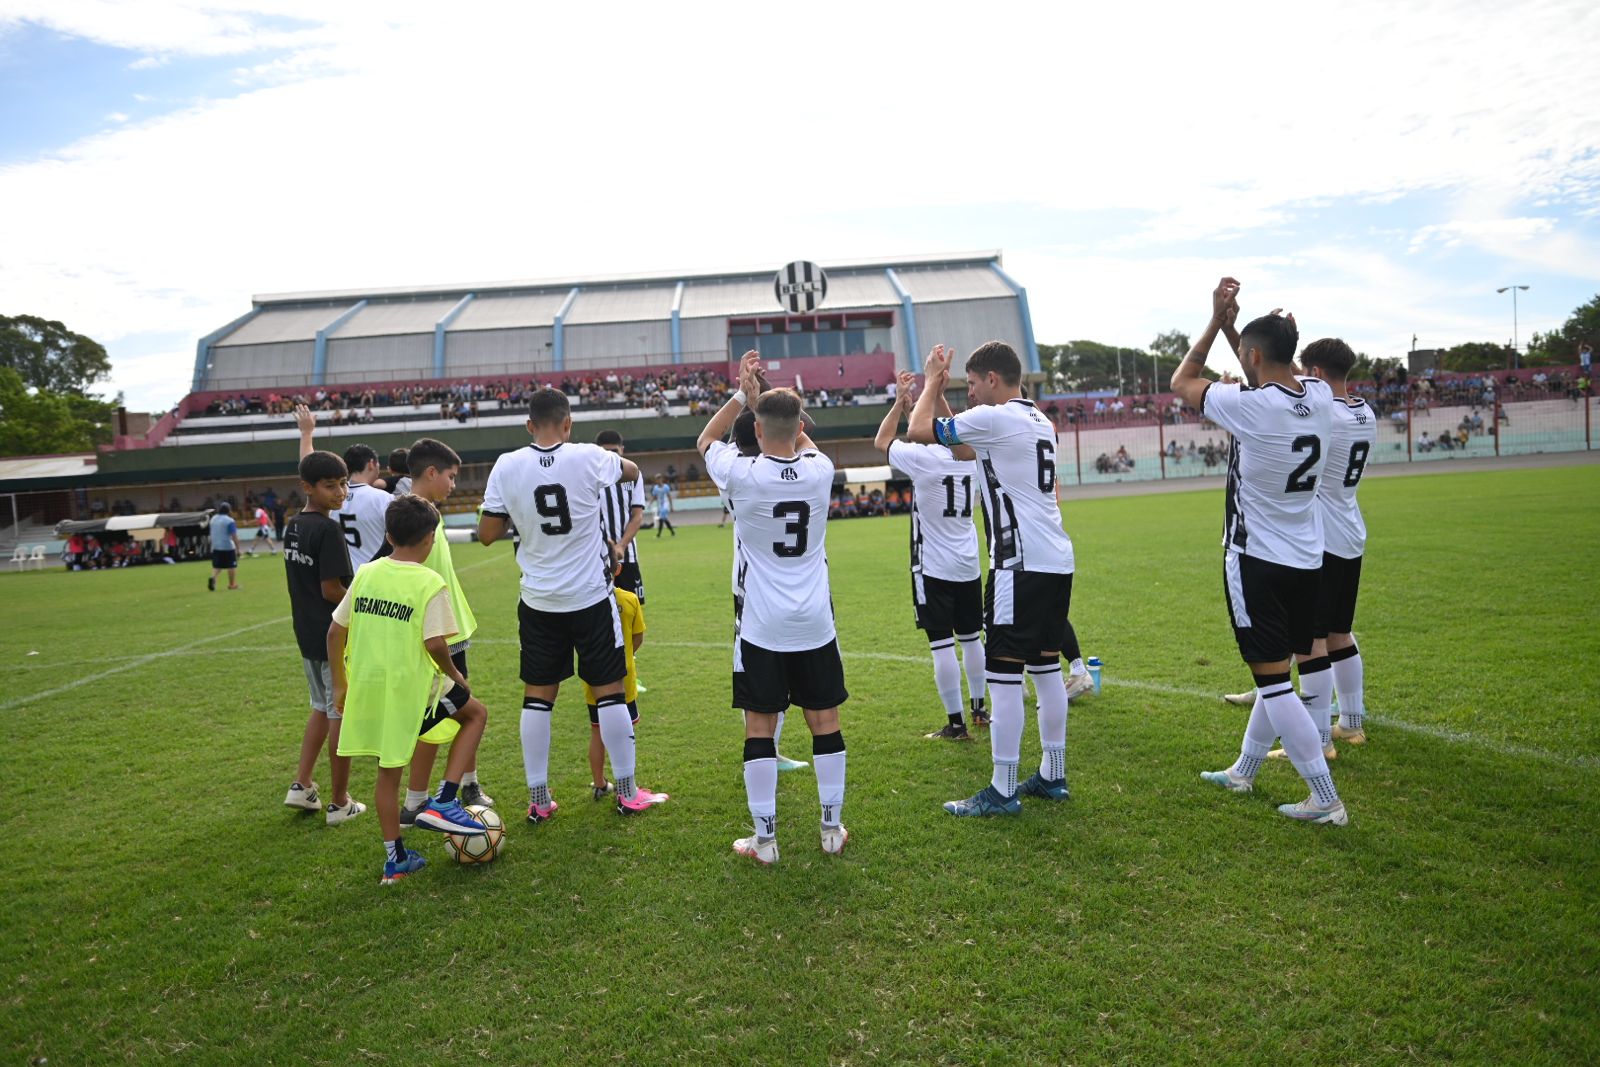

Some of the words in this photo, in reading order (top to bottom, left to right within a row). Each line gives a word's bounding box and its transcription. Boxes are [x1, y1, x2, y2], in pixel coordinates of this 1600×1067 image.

[1036, 439, 1055, 493] 6
[1285, 434, 1321, 493] 2
[1343, 440, 1370, 487] 8
[534, 483, 572, 535] 9
[942, 475, 972, 517] 11
[339, 513, 362, 548] 5
[773, 501, 810, 557] 3
[354, 597, 414, 622] ORGANIZACION
[634, 586, 645, 599] 10
